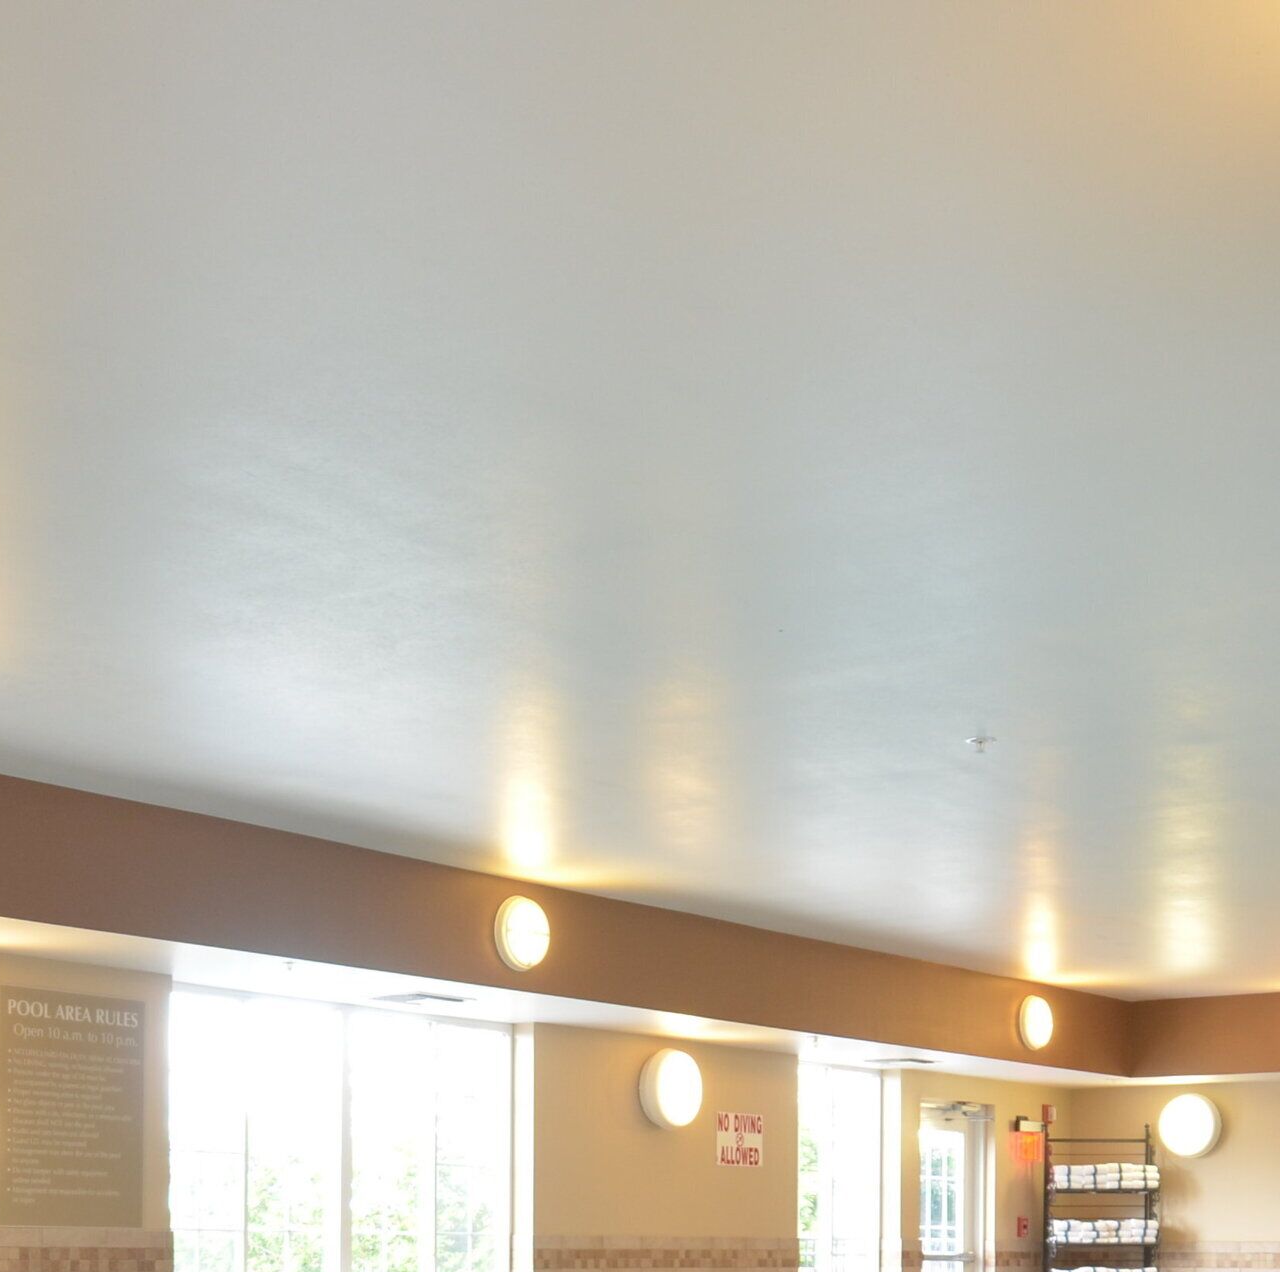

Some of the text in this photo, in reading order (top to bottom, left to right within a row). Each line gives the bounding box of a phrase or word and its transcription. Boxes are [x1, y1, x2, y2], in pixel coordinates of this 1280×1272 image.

[7, 998, 139, 1028] POOL AREA RULES
[13, 1022, 44, 1040] Open
[48, 1027, 60, 1040] 10
[87, 1031, 98, 1043] to
[102, 1032, 114, 1045] 10
[717, 1113, 762, 1134] NO DIVING
[720, 1146, 760, 1166] ALLOWED
